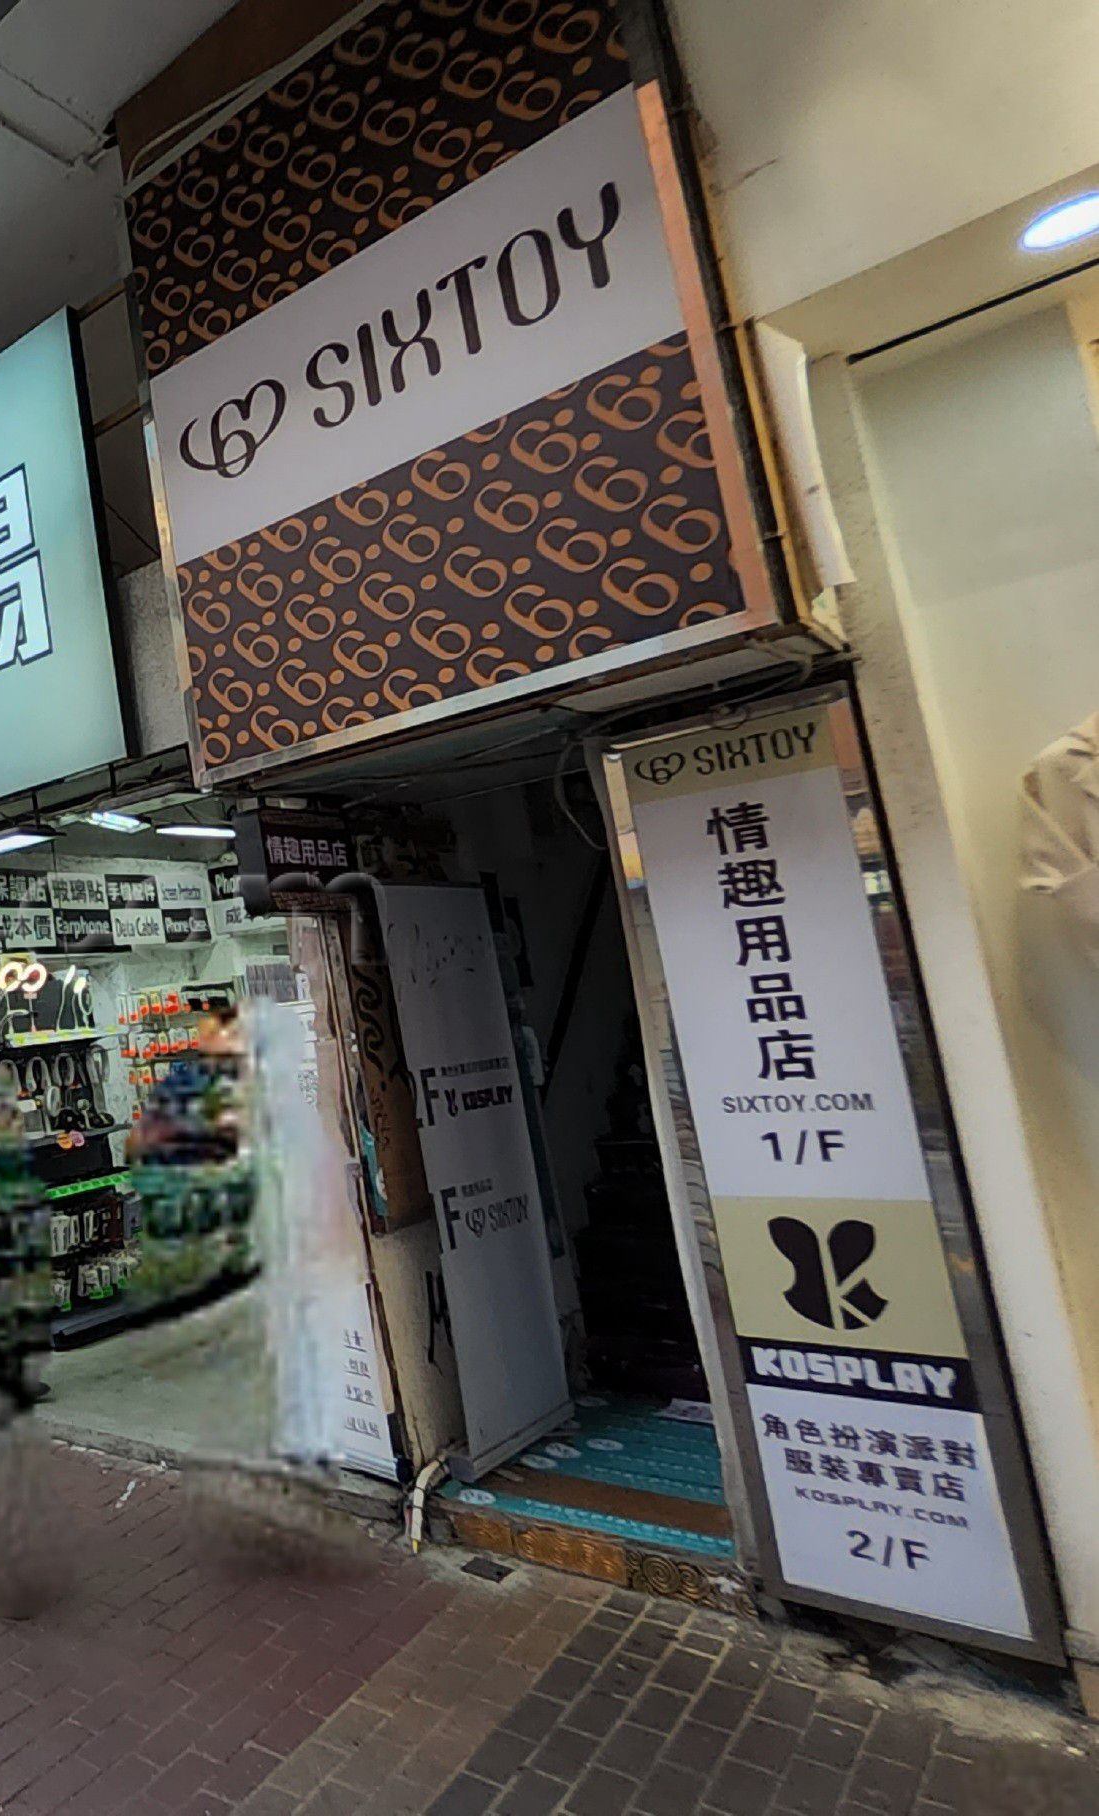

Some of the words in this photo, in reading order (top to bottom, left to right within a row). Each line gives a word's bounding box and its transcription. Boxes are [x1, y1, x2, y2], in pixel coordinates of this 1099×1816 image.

[305, 182, 620, 430] SIXTOY
[693, 721, 818, 776] SIXTOY
[266, 835, 348, 867] 情趣用品店
[56, 914, 110, 939] Earphone
[706, 801, 818, 1082] 情趣用品店
[722, 1091, 876, 1114] SIXTOY.COM
[759, 1128, 846, 1166] 1/F
[751, 1346, 957, 1399] KOSPLAY
[761, 1412, 978, 1471] 角色扮演派對
[784, 1448, 967, 1503] 服裝專賣店
[794, 1485, 969, 1529] KOSPLAY.COM
[846, 1529, 932, 1572] 2/F
